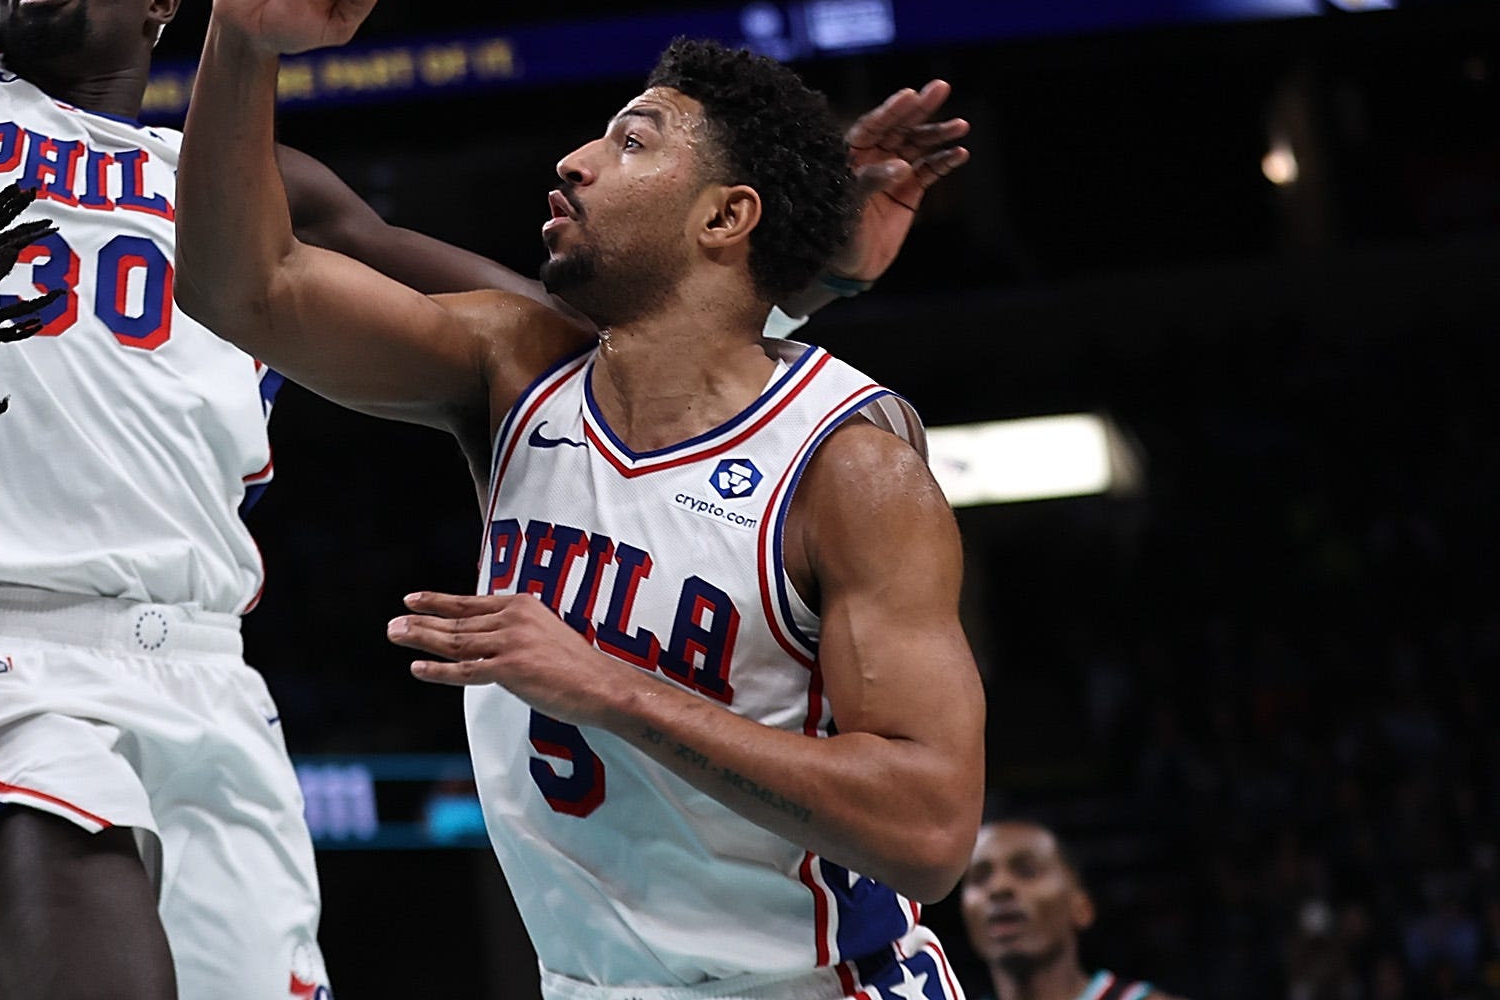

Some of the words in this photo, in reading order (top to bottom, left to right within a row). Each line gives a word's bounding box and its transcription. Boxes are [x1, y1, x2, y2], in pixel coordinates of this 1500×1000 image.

[675, 493, 757, 529] crypto.com
[488, 519, 740, 706] PHILA
[529, 707, 605, 818] 5
